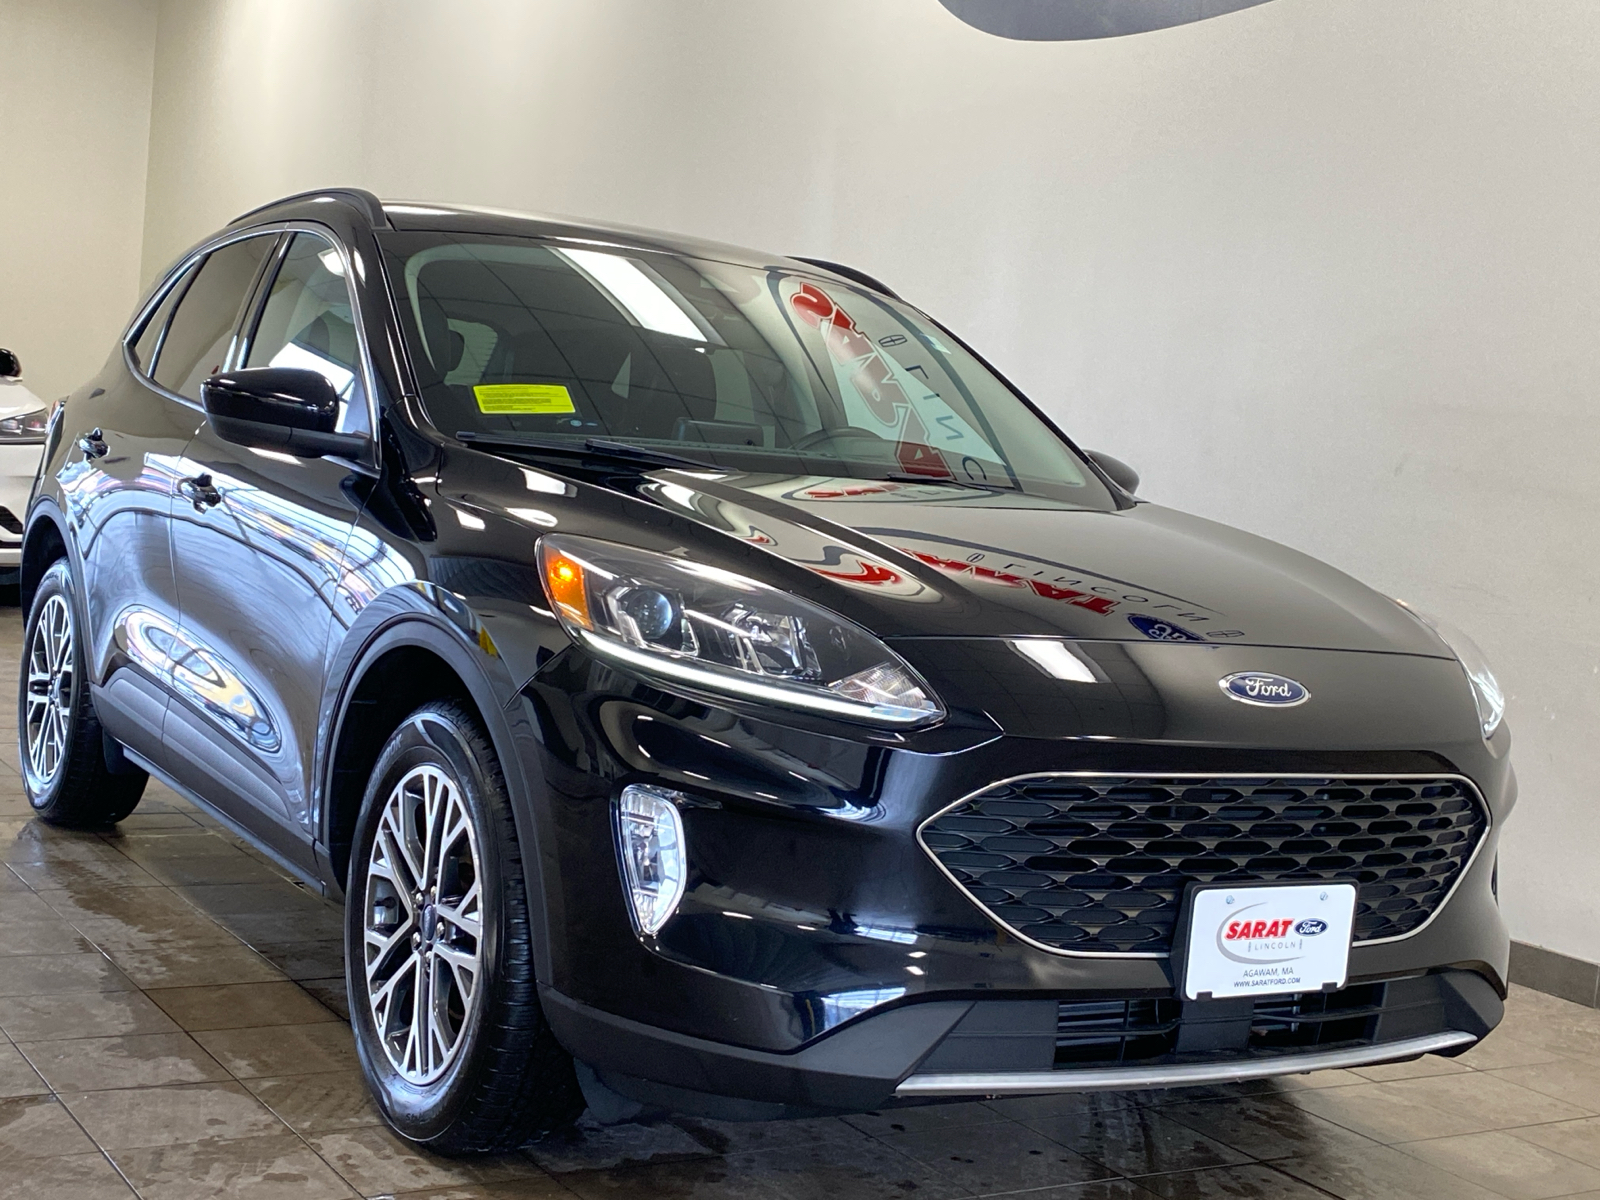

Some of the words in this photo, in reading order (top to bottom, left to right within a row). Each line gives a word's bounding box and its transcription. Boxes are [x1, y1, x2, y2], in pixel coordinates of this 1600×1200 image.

[1245, 677, 1292, 697] Ford
[1225, 918, 1294, 941] SARAT
[1299, 920, 1323, 934] Ford
[1254, 941, 1297, 951] LINCOLN
[1243, 967, 1279, 978] AGAWAM,
[1281, 966, 1294, 976] MA
[1233, 977, 1301, 988] WWW.SARATFORD.COM
